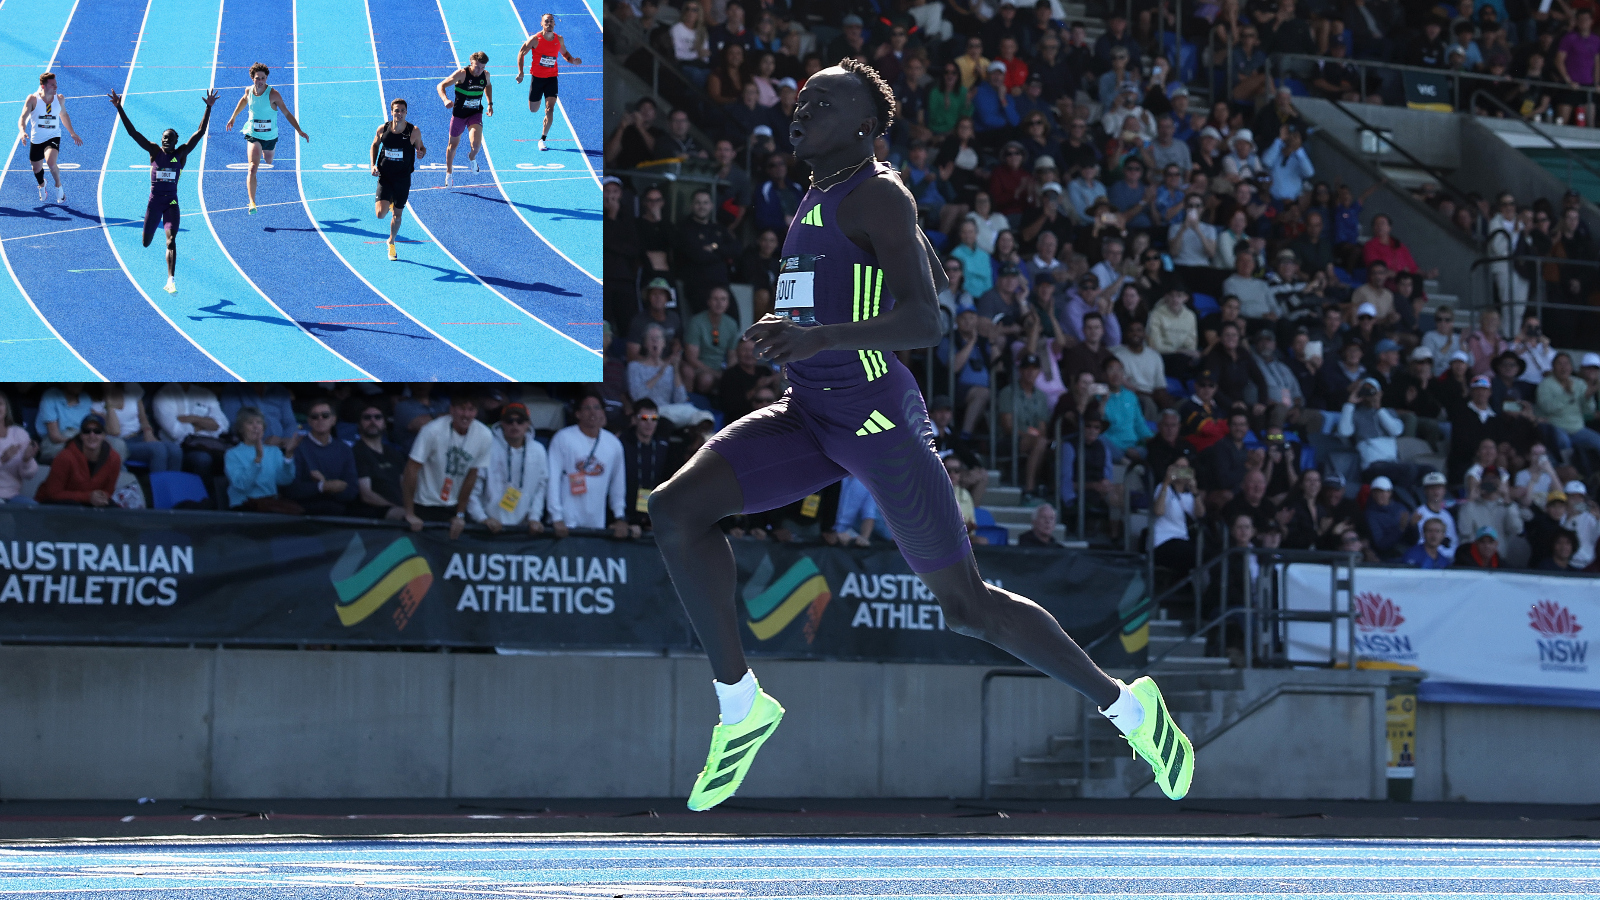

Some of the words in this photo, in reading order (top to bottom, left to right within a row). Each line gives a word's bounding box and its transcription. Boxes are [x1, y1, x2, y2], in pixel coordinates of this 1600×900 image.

[443, 553, 627, 583] AUSTRALIAN
[0, 574, 178, 606] ATHLETICS
[456, 586, 614, 614] ATHLETICS
[851, 602, 946, 630] ATHLET
[1354, 635, 1412, 653] NSW
[1536, 640, 1588, 663] NSW
